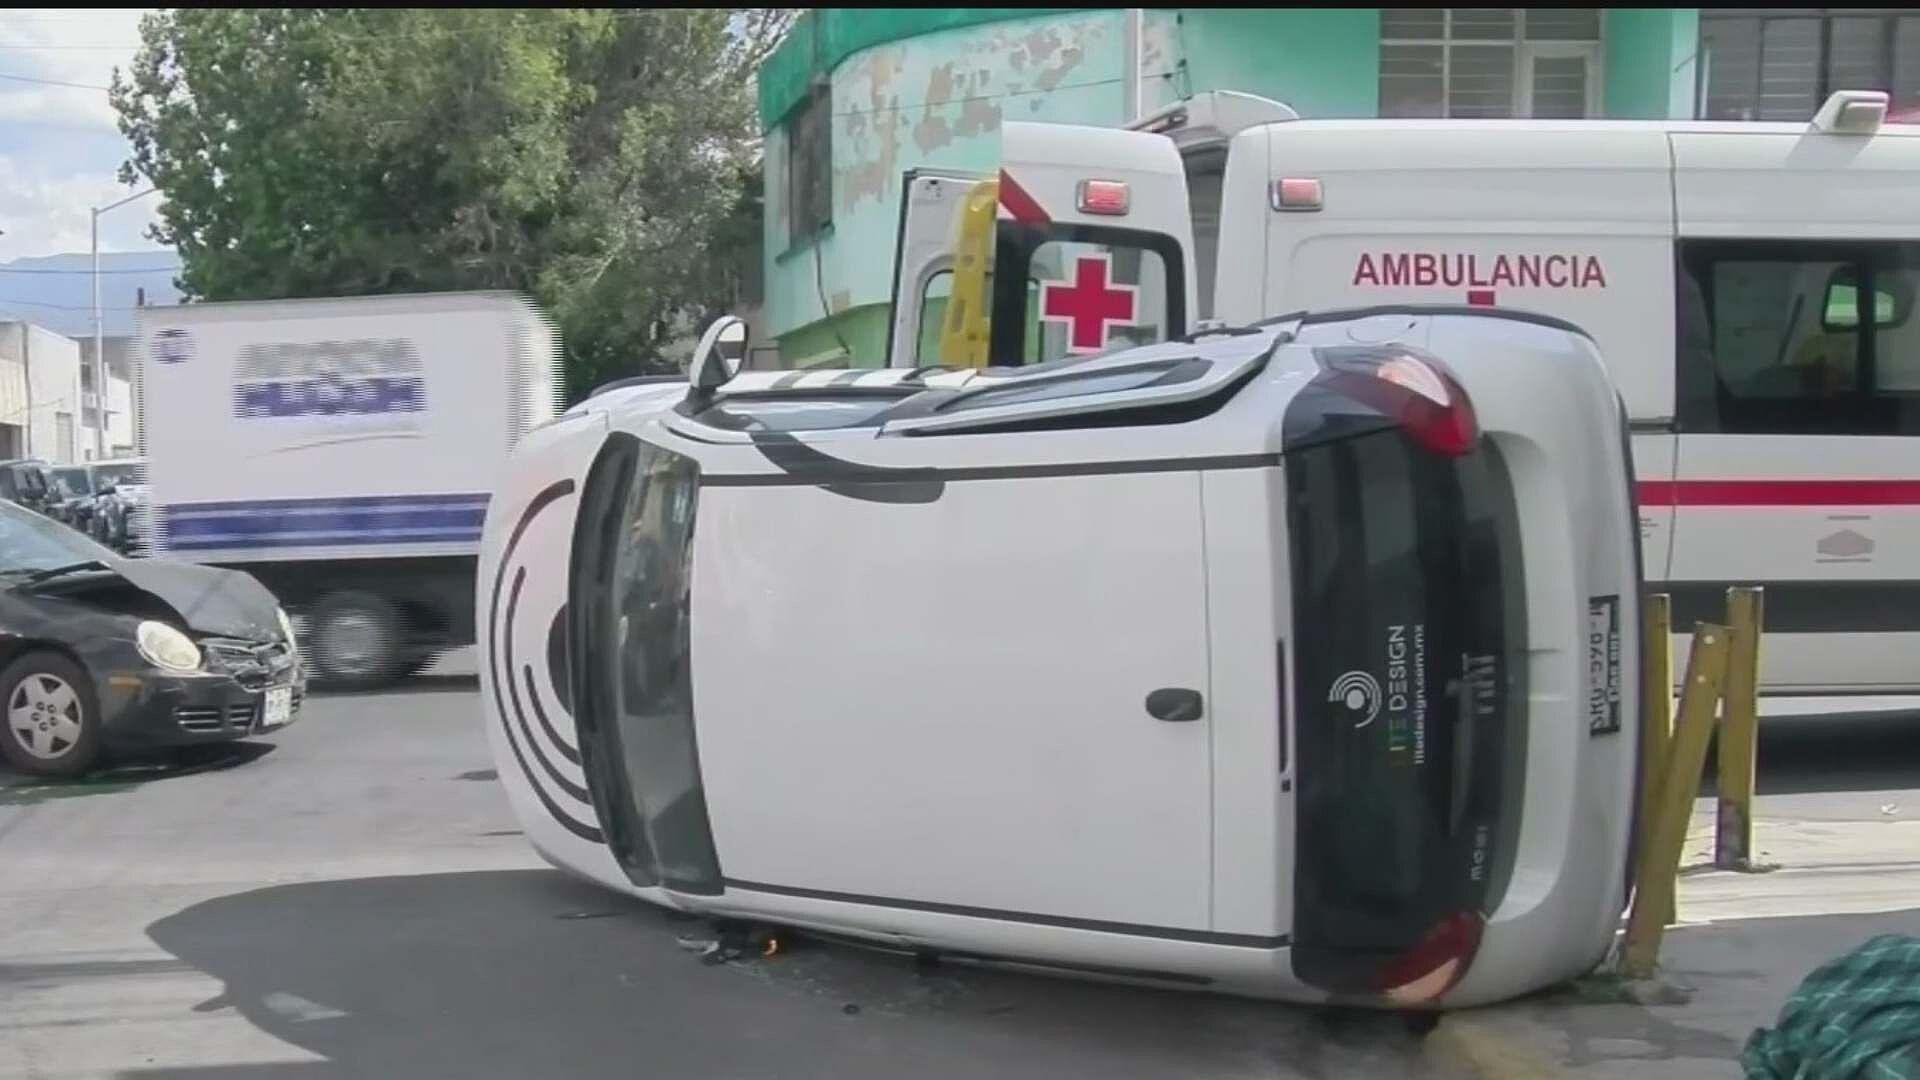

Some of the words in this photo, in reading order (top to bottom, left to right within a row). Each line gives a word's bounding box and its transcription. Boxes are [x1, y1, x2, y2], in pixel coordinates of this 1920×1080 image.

[1353, 253, 1606, 288] AMBULANCIA
[1388, 625, 1407, 711] DESIGN
[1413, 624, 1427, 764] litedesign.com.mx
